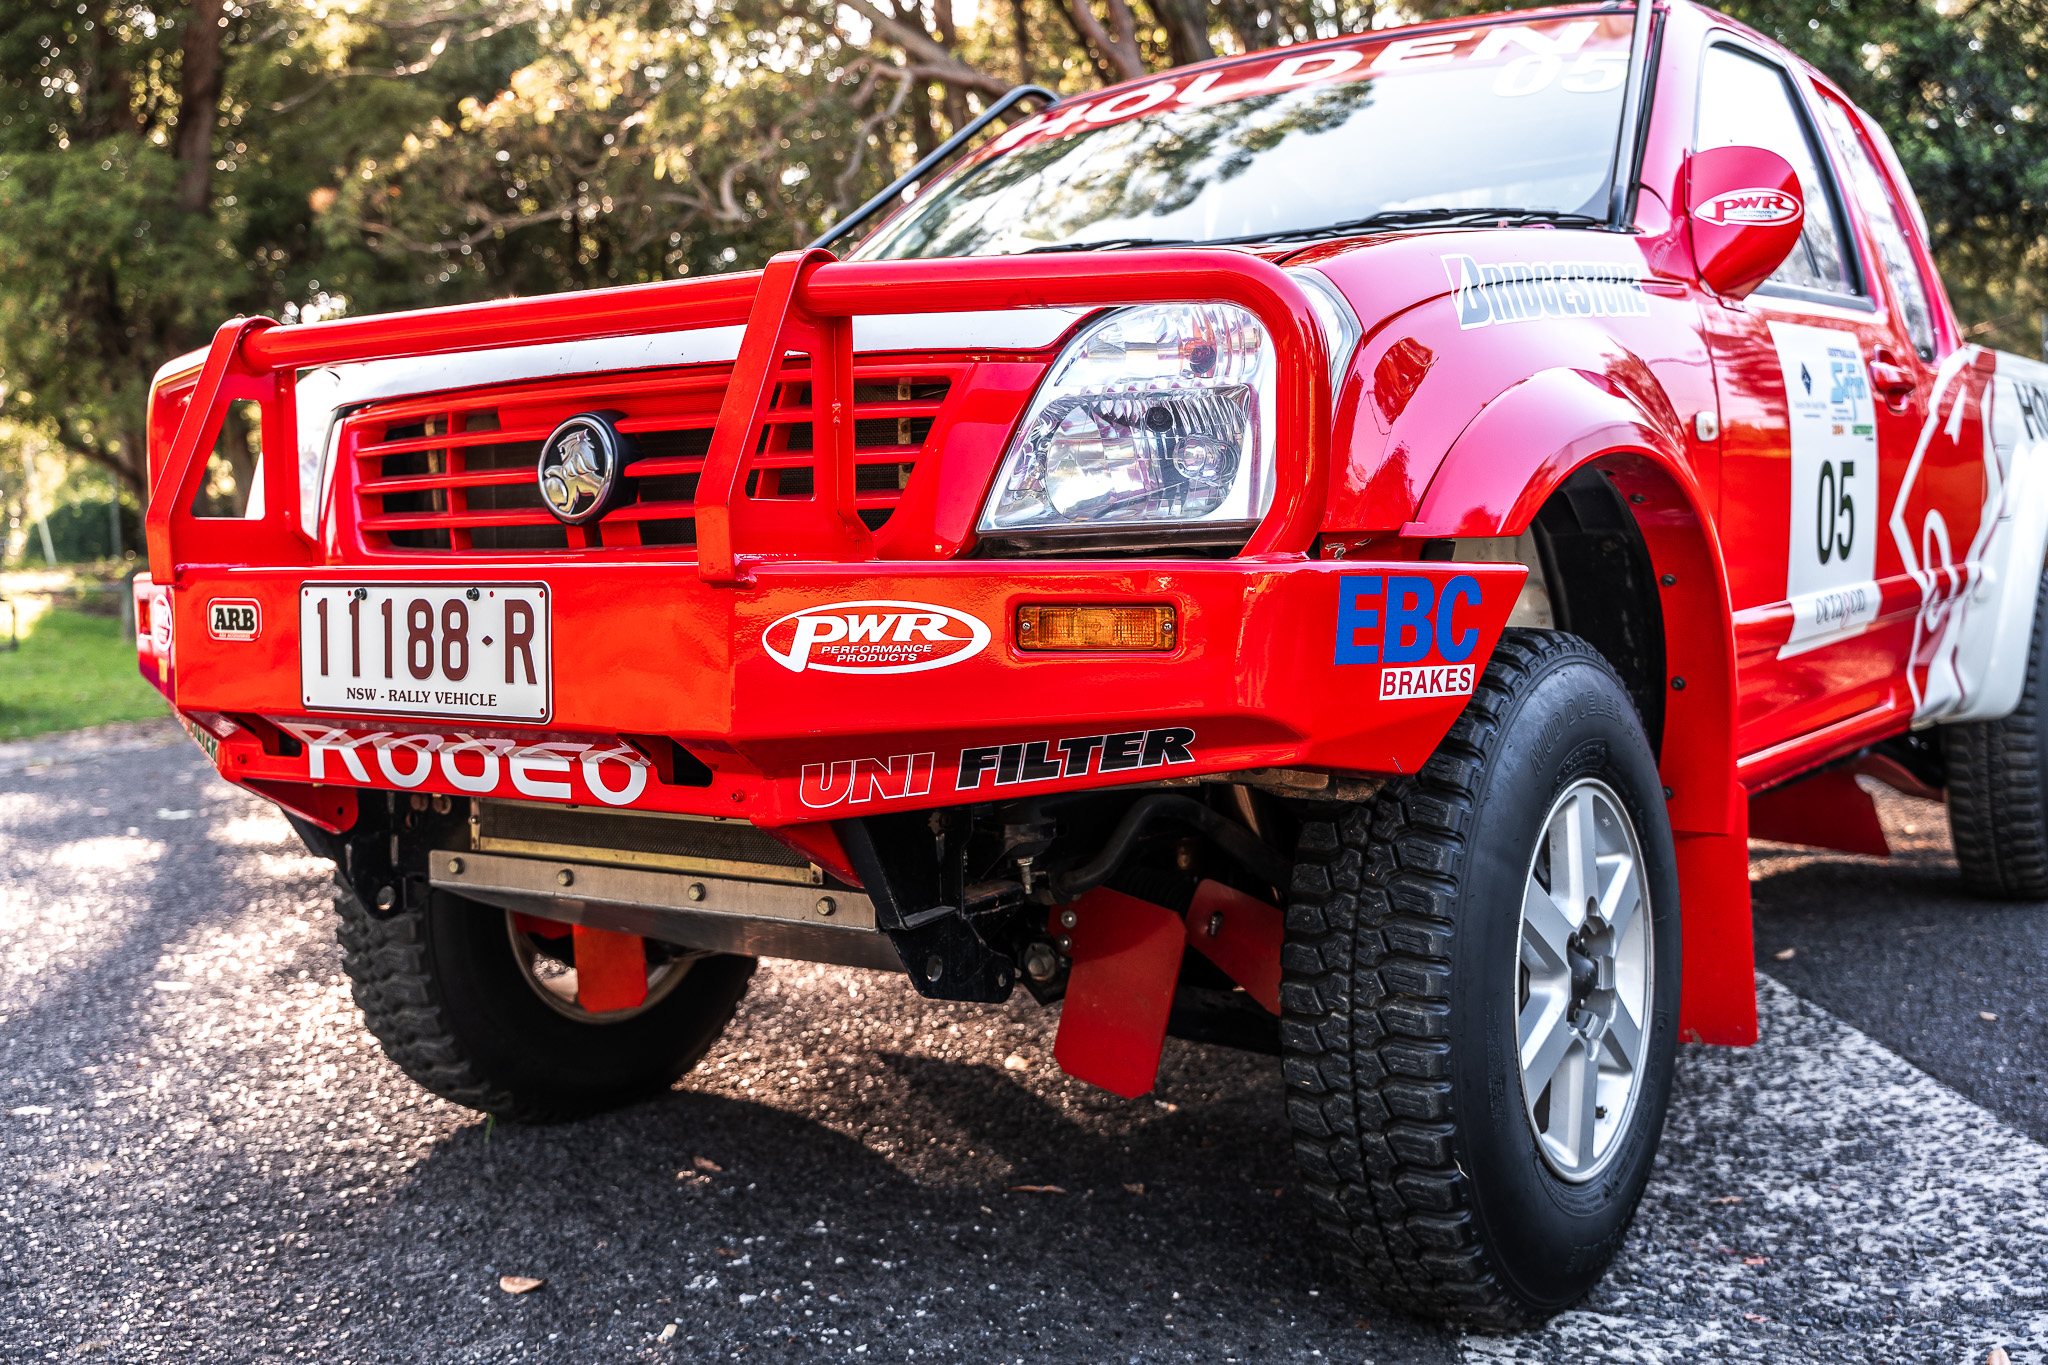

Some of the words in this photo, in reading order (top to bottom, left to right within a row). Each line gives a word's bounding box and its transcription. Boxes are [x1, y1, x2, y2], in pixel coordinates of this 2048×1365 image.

[994, 21, 1600, 152] HOLDEN
[1492, 51, 1630, 97] 05
[1713, 195, 1793, 222] PWR
[1441, 254, 1650, 329] BRIDGESTONE
[1817, 460, 1855, 565] 05
[214, 607, 255, 631] ARB
[787, 612, 972, 673] PWR
[1334, 575, 1482, 665] EBC
[821, 644, 932, 655] PERFORMANCE
[836, 653, 917, 663] PRODUCTS
[346, 688, 377, 702] NSW
[389, 690, 431, 704] RALLY
[434, 692, 497, 707] VEHICLE
[1383, 668, 1471, 696] BRAKES
[290, 724, 649, 806] RODEO
[800, 752, 935, 808] UNI
[955, 727, 1196, 791] FILTER
